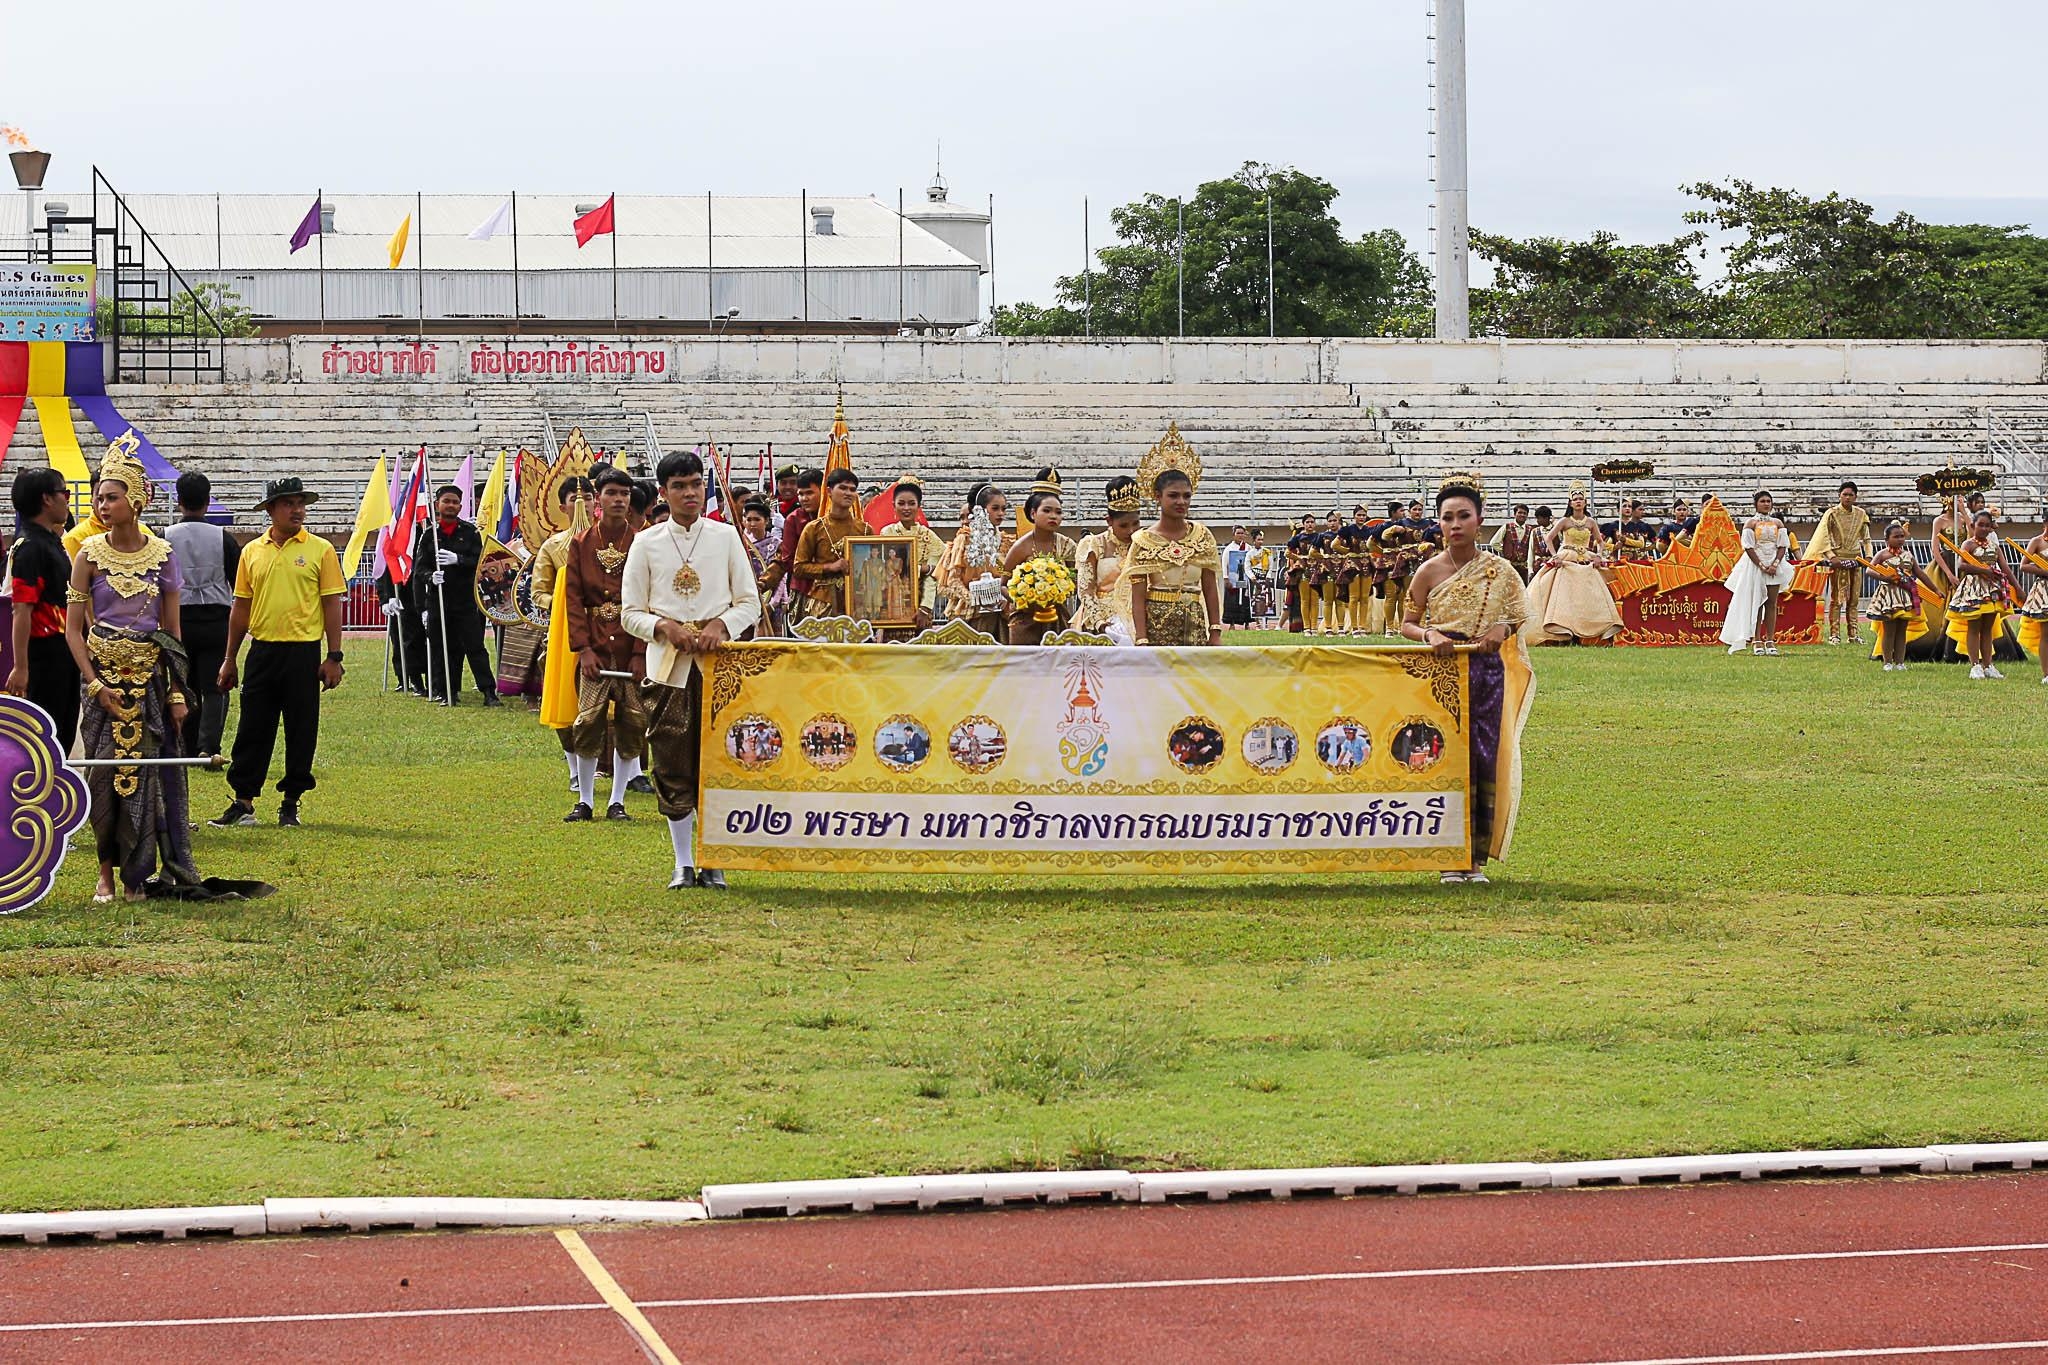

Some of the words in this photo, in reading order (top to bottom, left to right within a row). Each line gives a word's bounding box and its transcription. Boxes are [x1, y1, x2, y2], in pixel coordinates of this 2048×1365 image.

[31, 271, 85, 283] Games
[322, 342, 440, 374] ถ้าอยากได้
[471, 342, 665, 374] ต้องออกกำลังกาย
[1601, 467, 1646, 475] Cheerleader
[1935, 478, 1978, 489] Yellow
[726, 803, 793, 836] ๗๒
[803, 809, 910, 838] พรรษา
[920, 796, 1446, 839] มหาวชิราลงกรณบรมราชวงศ์จักรี
